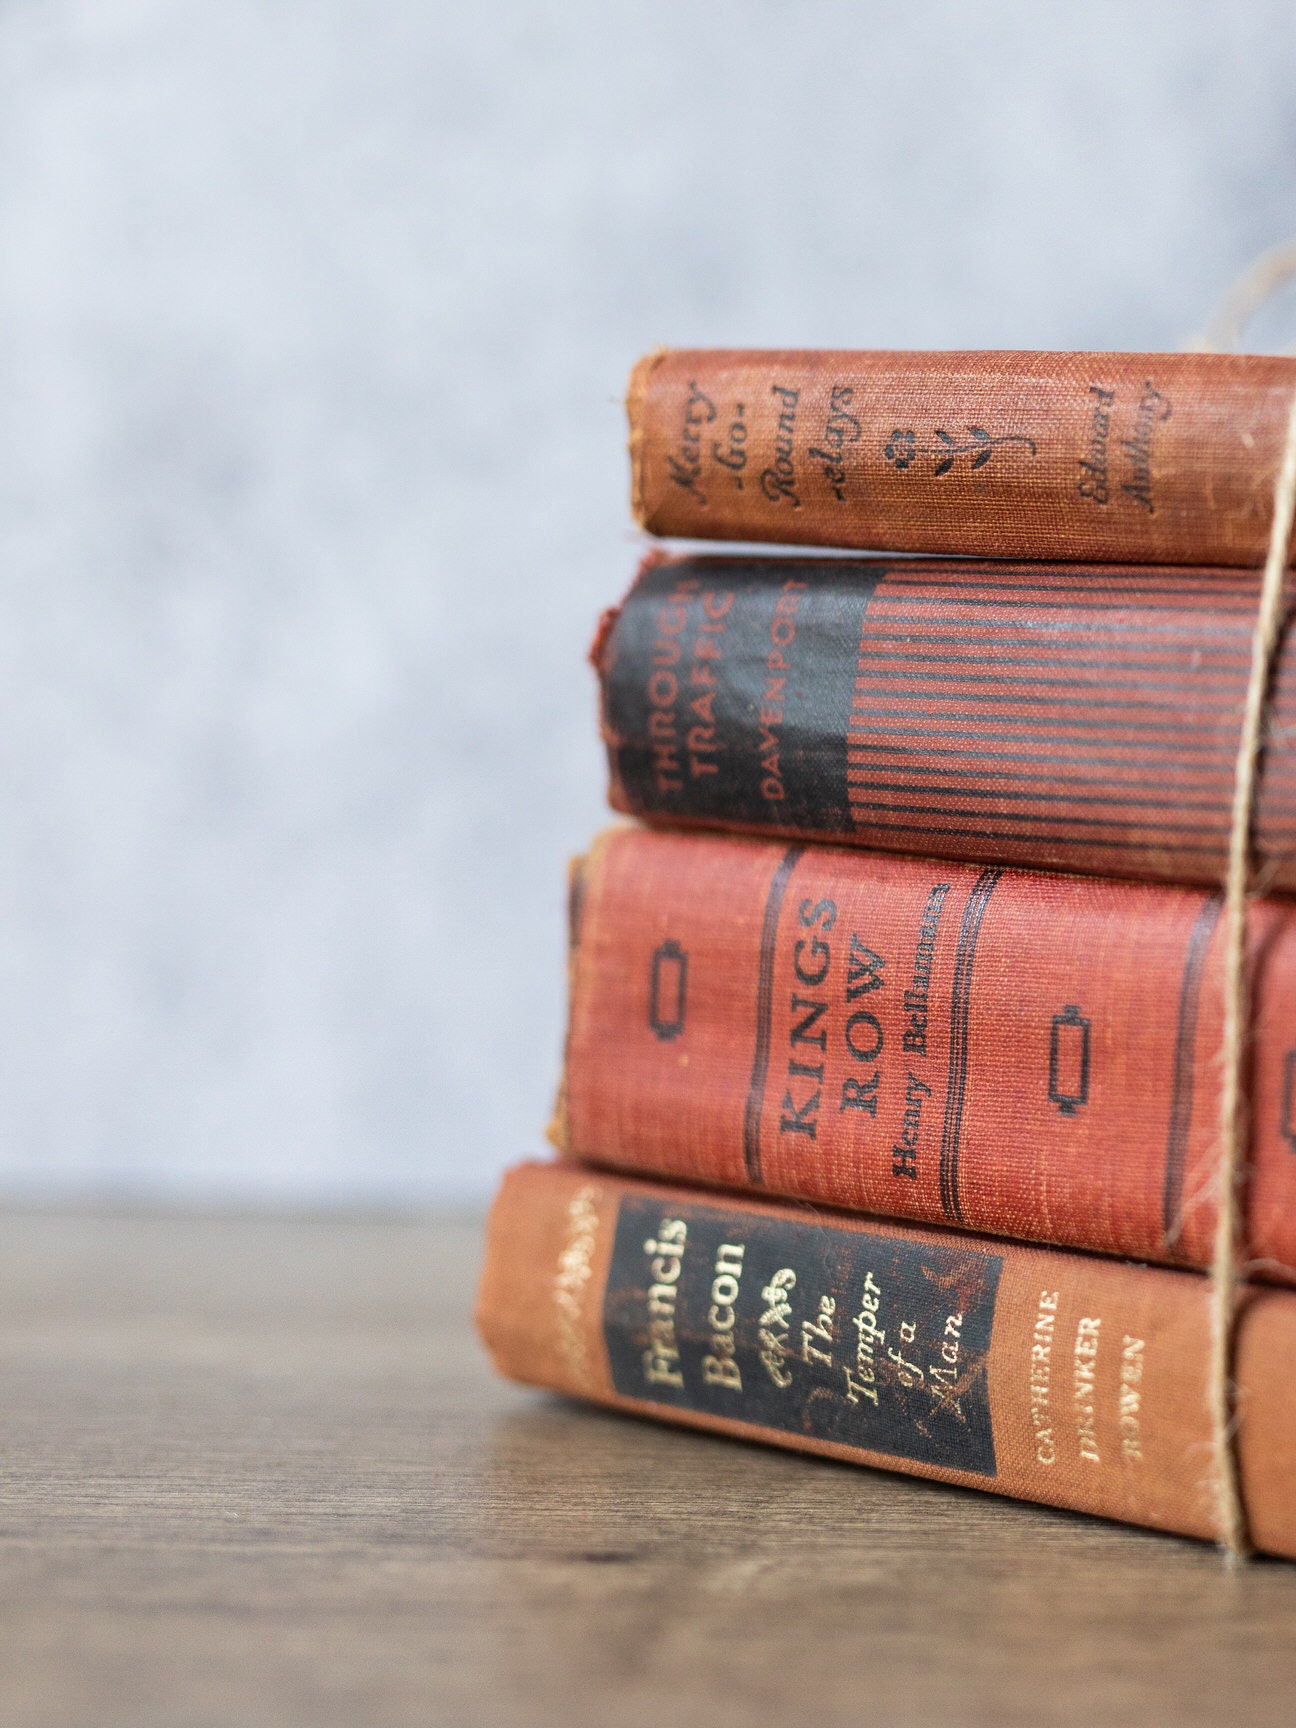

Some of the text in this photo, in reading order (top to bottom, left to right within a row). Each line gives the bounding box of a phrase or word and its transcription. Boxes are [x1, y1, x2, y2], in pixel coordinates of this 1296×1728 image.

[760, 385, 801, 507] Round
[687, 591, 735, 778] TRAFFIC
[759, 579, 808, 800] DAVENPORT
[779, 898, 838, 1141] KINGS
[839, 933, 886, 1119] ROW
[892, 1072, 932, 1180] Henry
[642, 1218, 687, 1388] Francis
[702, 1244, 745, 1392] Bacon
[801, 1295, 836, 1368] The
[843, 1271, 886, 1407] Temper
[888, 1320, 924, 1388] of a
[927, 1312, 966, 1418] Man
[1029, 1290, 1060, 1465] CATHERINE
